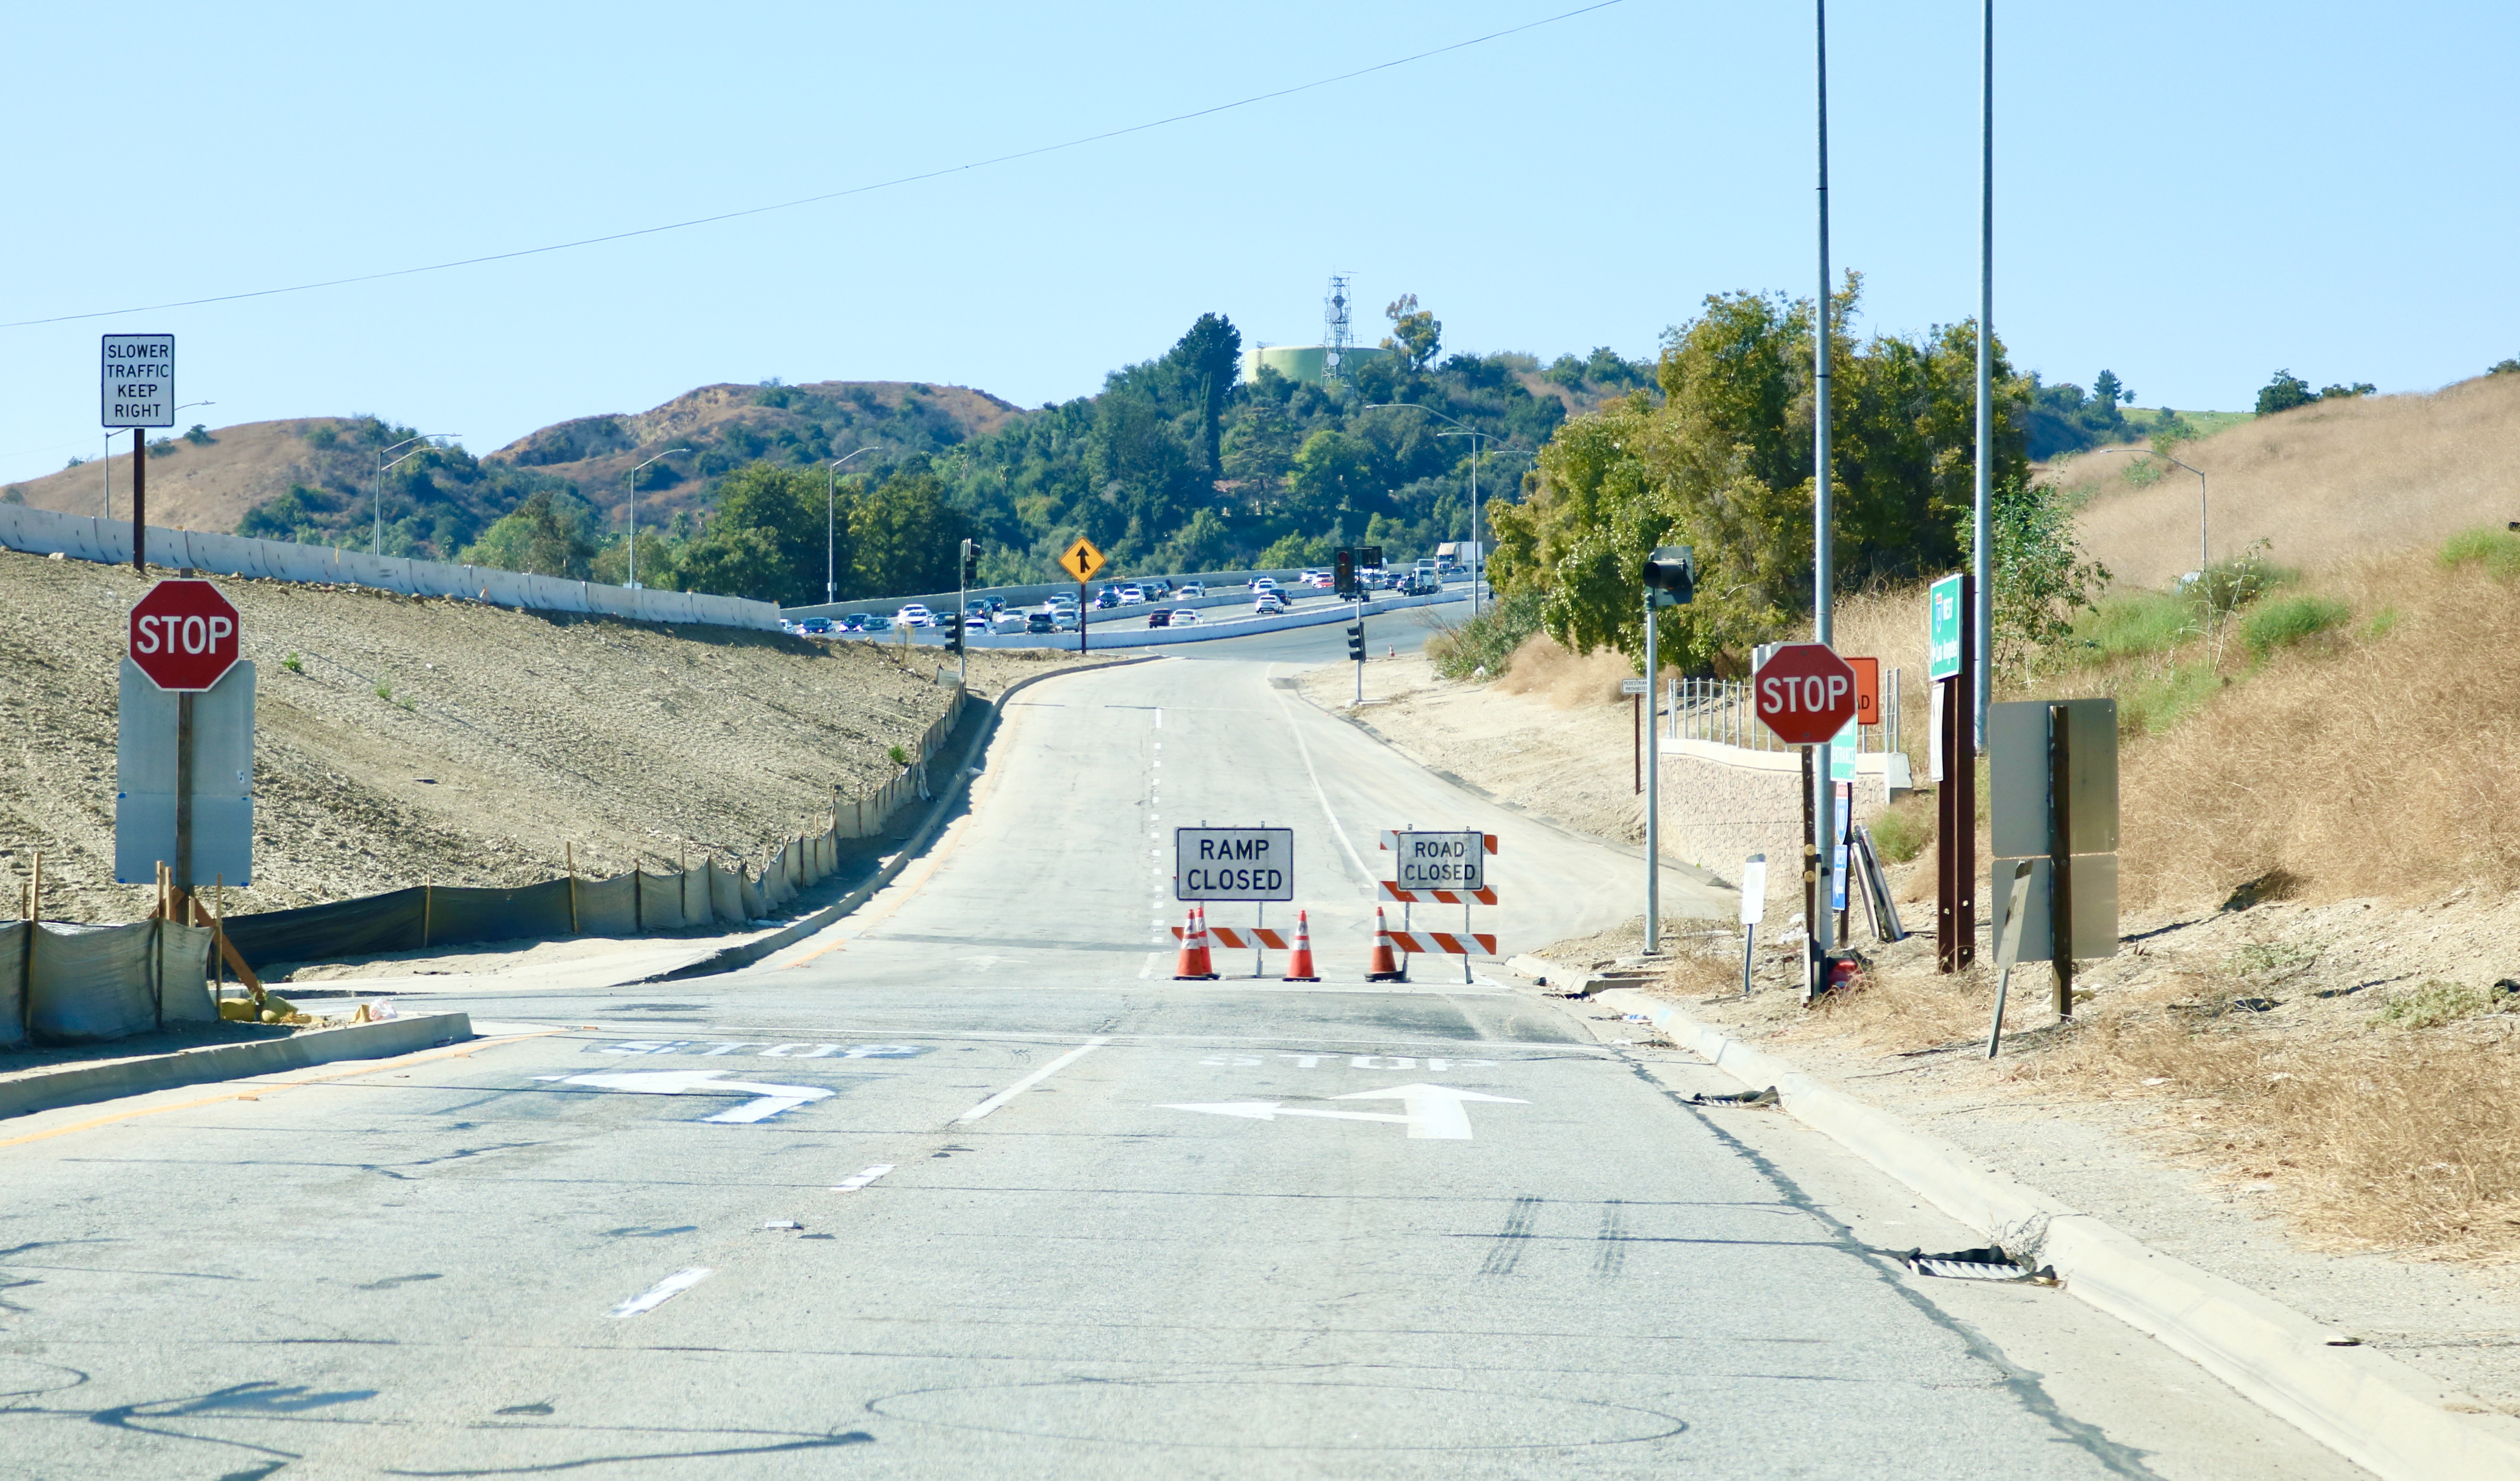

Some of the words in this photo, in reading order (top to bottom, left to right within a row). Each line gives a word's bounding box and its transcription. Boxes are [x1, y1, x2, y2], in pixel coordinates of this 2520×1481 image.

[108, 345, 169, 358] SLOWER
[107, 364, 169, 378] TRAFFIC
[118, 384, 158, 397] KEEP
[115, 404, 161, 417] RIGHT
[1943, 597, 1953, 620] WEST
[137, 615, 232, 654] STOP
[1763, 675, 1848, 714] STOP
[1833, 746, 1855, 765] ENTRANCE
[1839, 808, 1845, 831] 10
[1201, 839, 1269, 860] RAMP
[1416, 842, 1465, 858] ROAD
[1835, 850, 1846, 865] WEST
[1188, 869, 1282, 890] CLOSED
[1405, 864, 1476, 880] CLOSED
[599, 1041, 921, 1059] STOP
[1198, 1054, 1499, 1071] STOP
